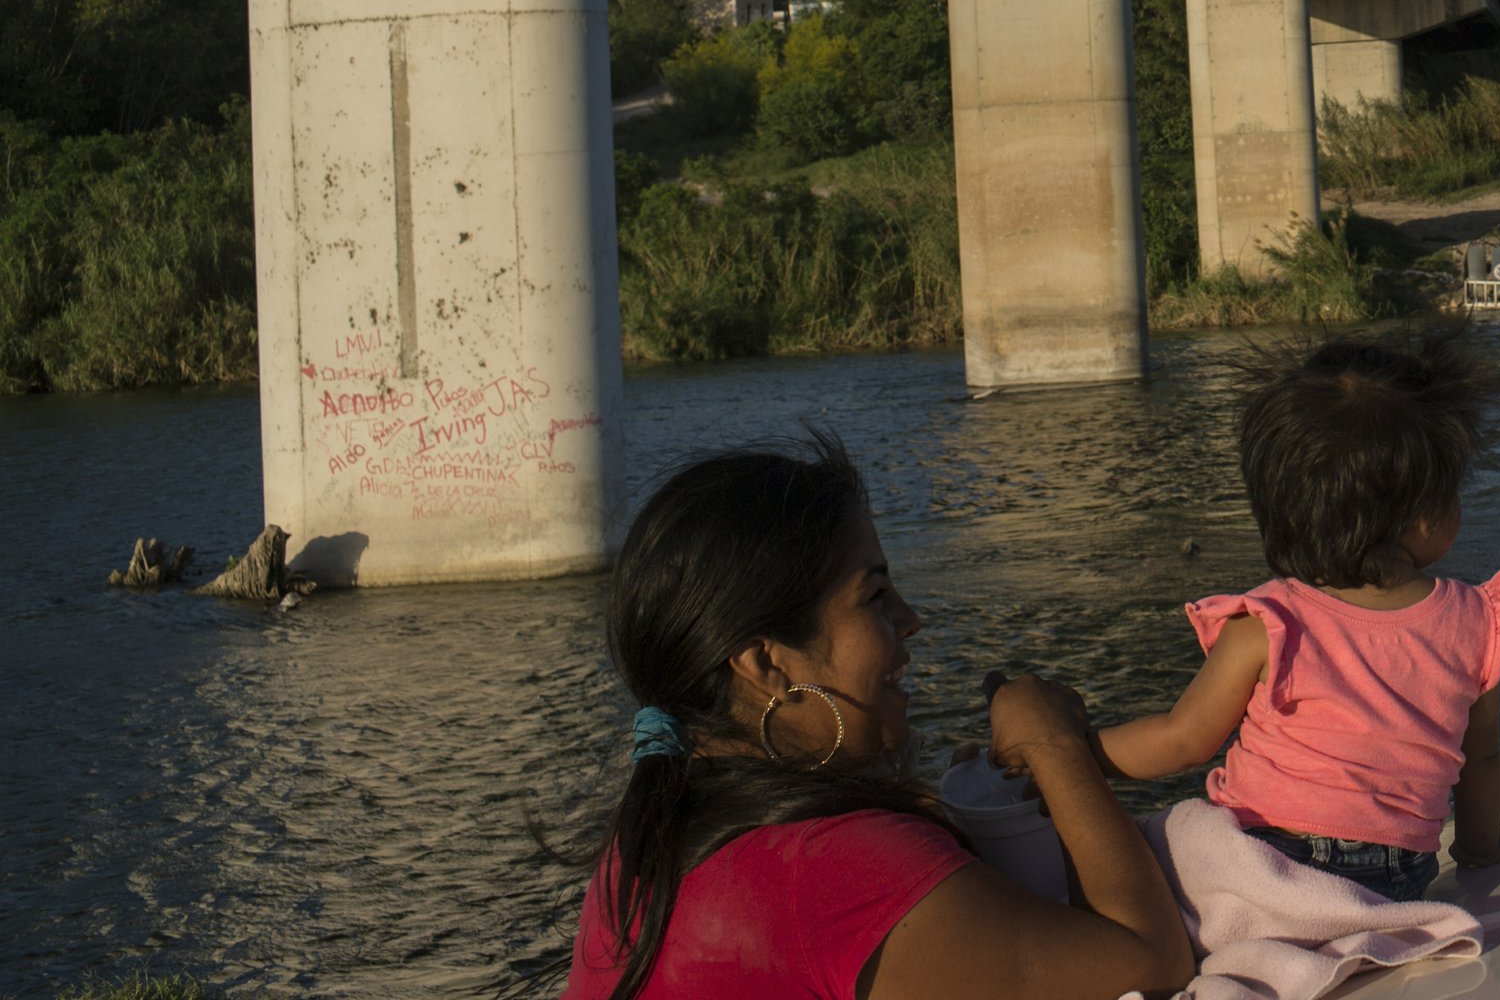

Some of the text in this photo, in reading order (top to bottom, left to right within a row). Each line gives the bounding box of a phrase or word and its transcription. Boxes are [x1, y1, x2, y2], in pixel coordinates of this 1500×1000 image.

[409, 411, 487, 457] Irving
[328, 444, 366, 475] Aldo
[411, 463, 506, 481] CHUPENTINA
[360, 475, 402, 498] Alicia
